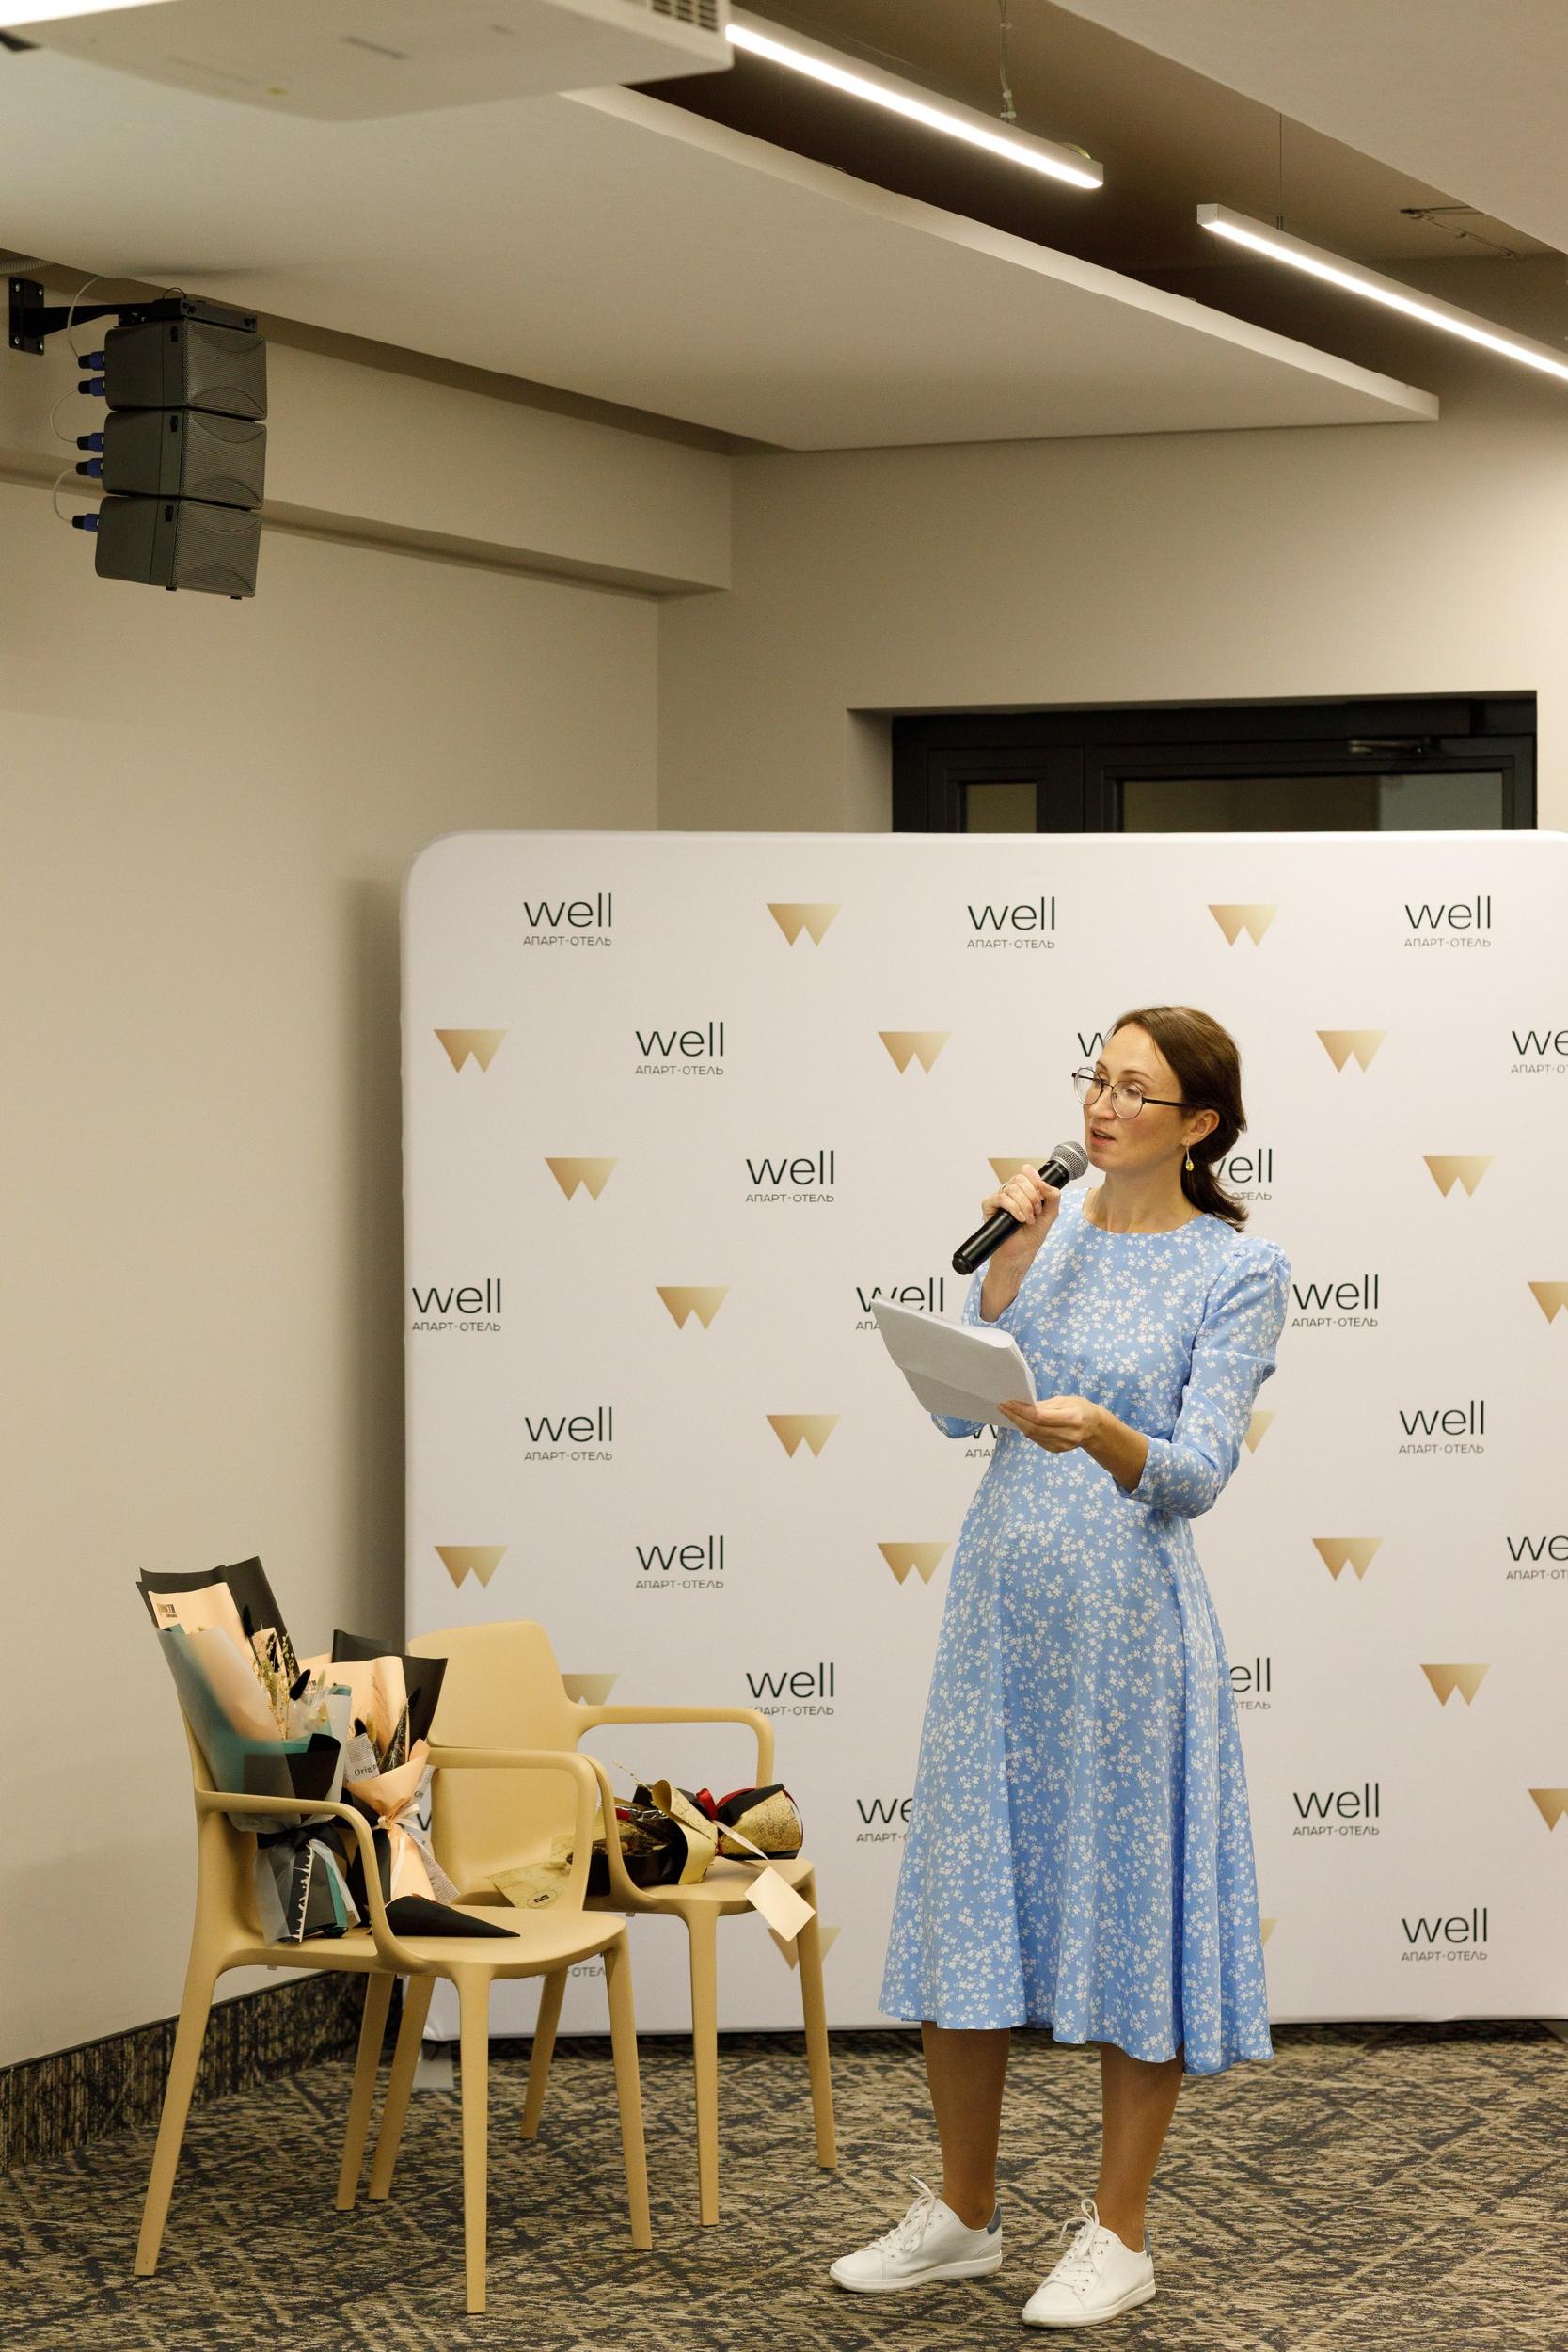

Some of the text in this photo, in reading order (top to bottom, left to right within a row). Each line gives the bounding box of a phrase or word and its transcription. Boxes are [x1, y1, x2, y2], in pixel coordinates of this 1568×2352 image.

[522, 892, 612, 929] well
[967, 895, 1055, 930] well
[1403, 894, 1492, 930] well
[635, 1022, 724, 1057] well
[1511, 1029, 1568, 1056] we
[745, 1150, 835, 1185] well
[1217, 1148, 1273, 1184] ell
[411, 1278, 501, 1314] well
[1291, 1274, 1379, 1311] well
[524, 1406, 613, 1443] well
[1399, 1399, 1485, 1436] well
[635, 1535, 724, 1571] well
[1506, 1535, 1568, 1562] we
[745, 1661, 834, 1698] well
[1228, 1657, 1271, 1692] ell
[855, 1797, 913, 1824] we
[1292, 1782, 1380, 1819] well
[1401, 1906, 1488, 1943] well
